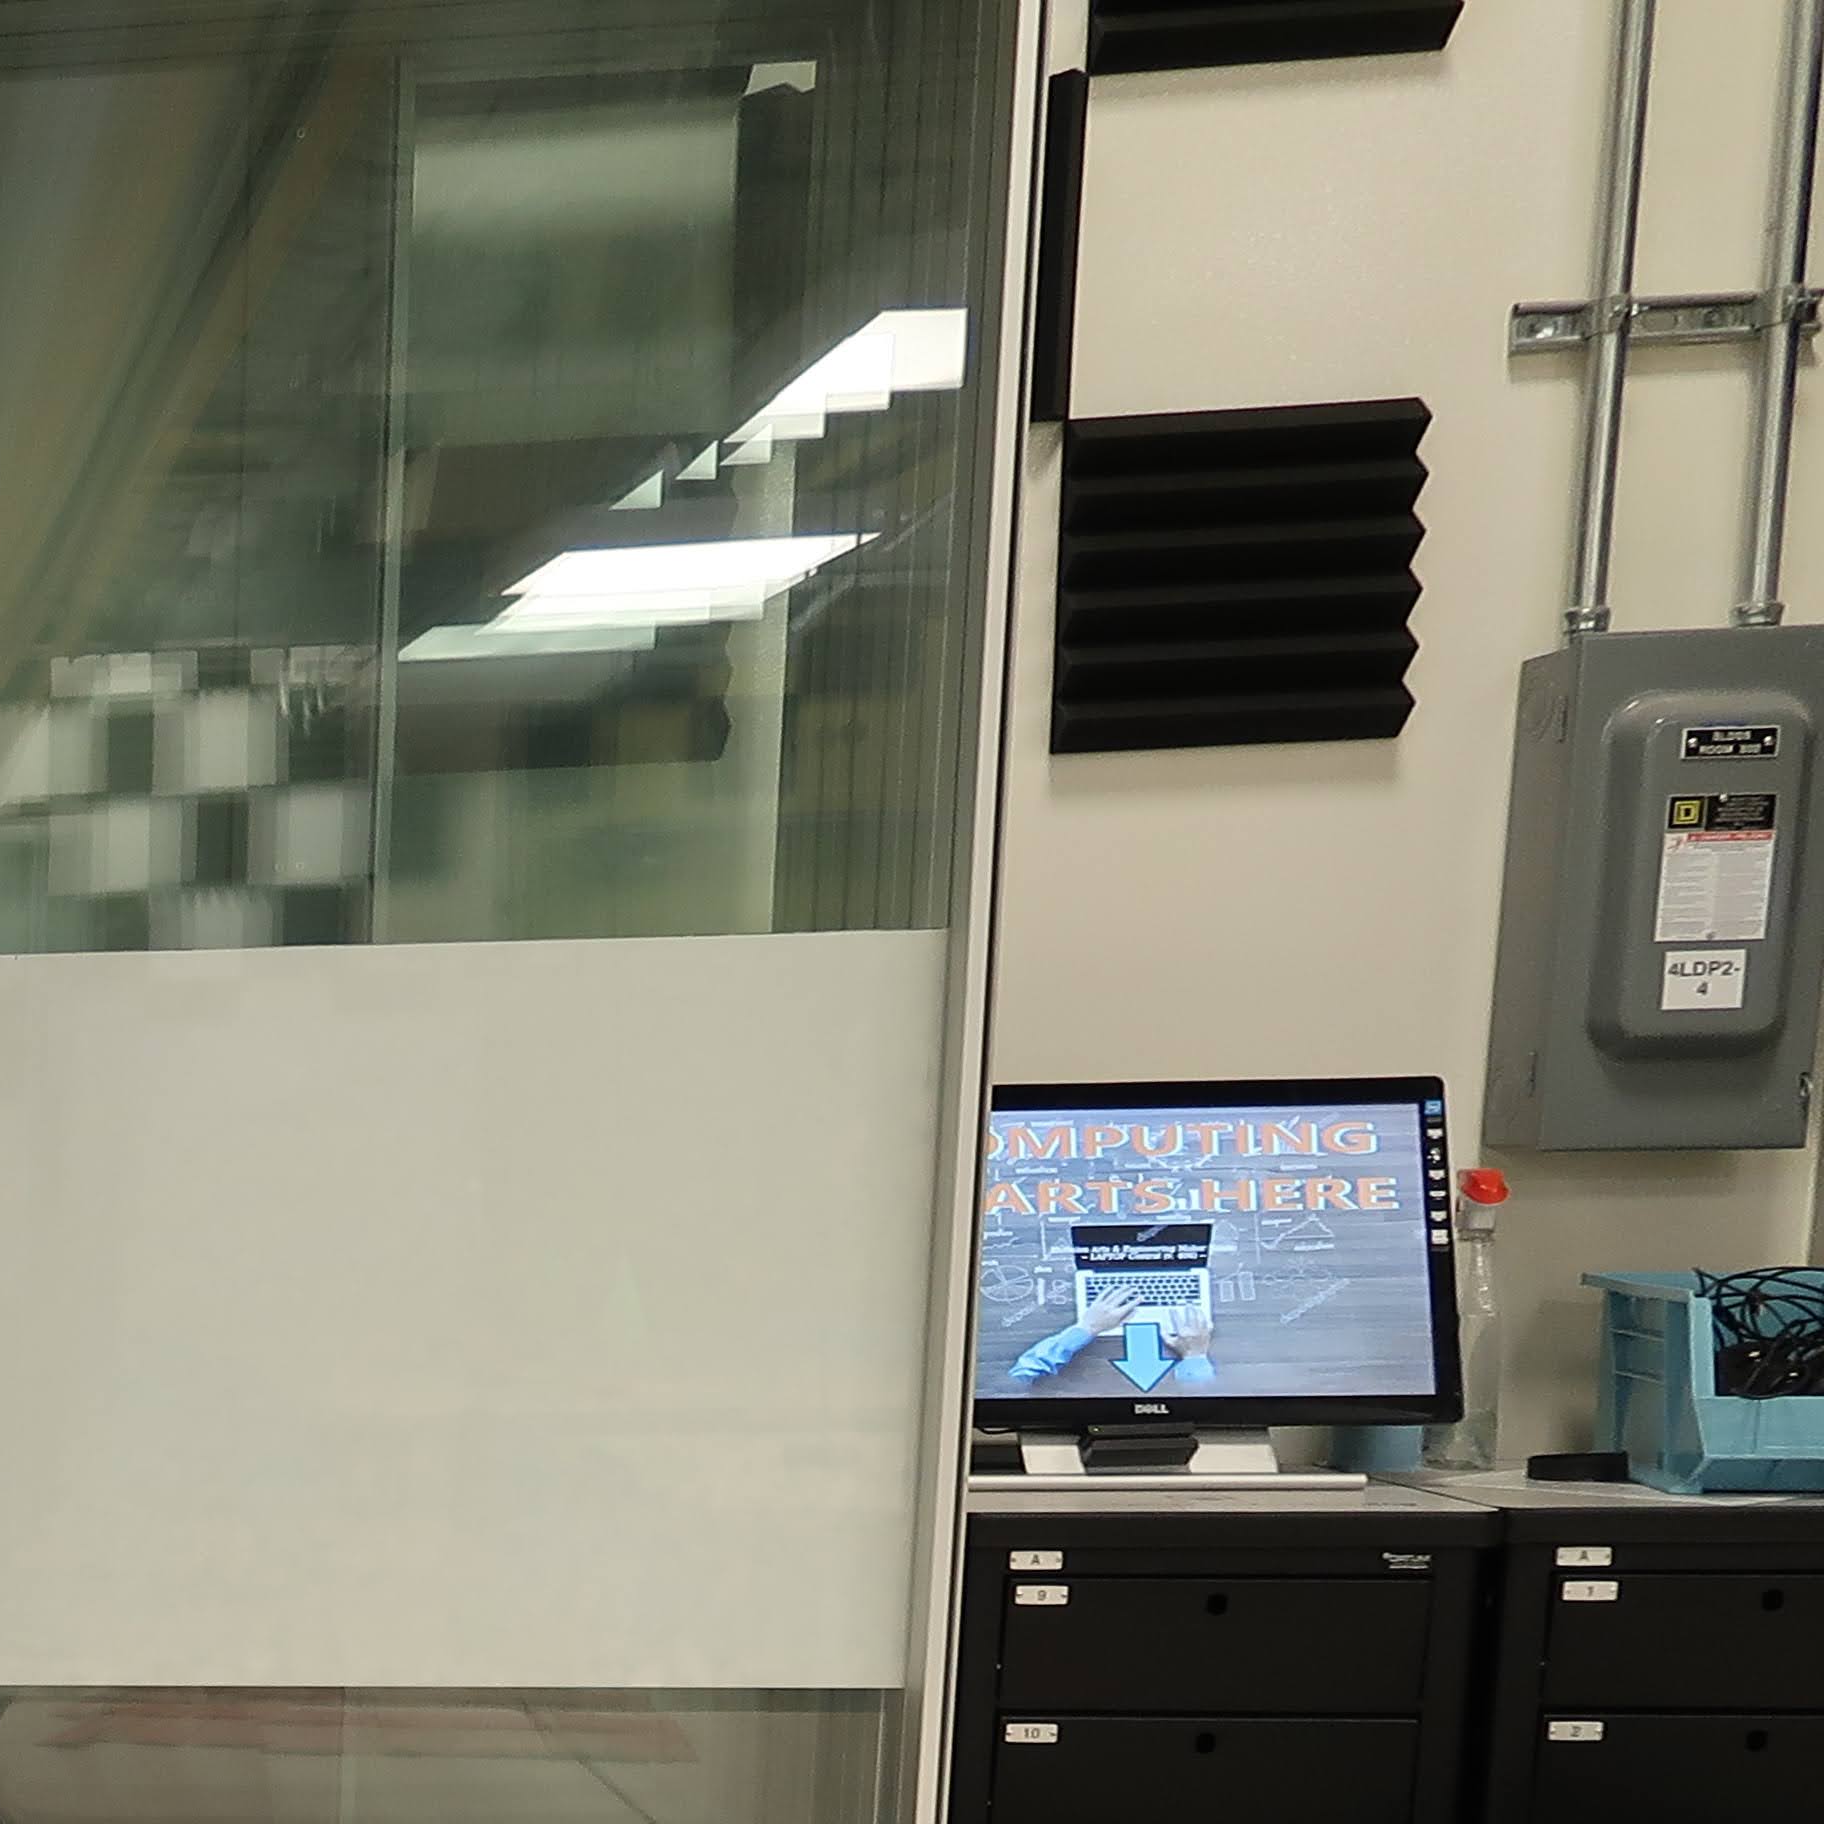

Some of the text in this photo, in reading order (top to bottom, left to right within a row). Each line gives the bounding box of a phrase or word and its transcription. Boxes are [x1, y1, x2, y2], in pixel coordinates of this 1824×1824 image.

[1667, 961, 1741, 977] 4LDP2-
[1696, 982, 1709, 995] 4
[1201, 1175, 1401, 1213] HERE
[1134, 1403, 1169, 1415] DELL
[1031, 1554, 1040, 1565] A
[1578, 1550, 1590, 1562] A
[1037, 1589, 1047, 1601] 9
[1023, 1727, 1041, 1740] 10
